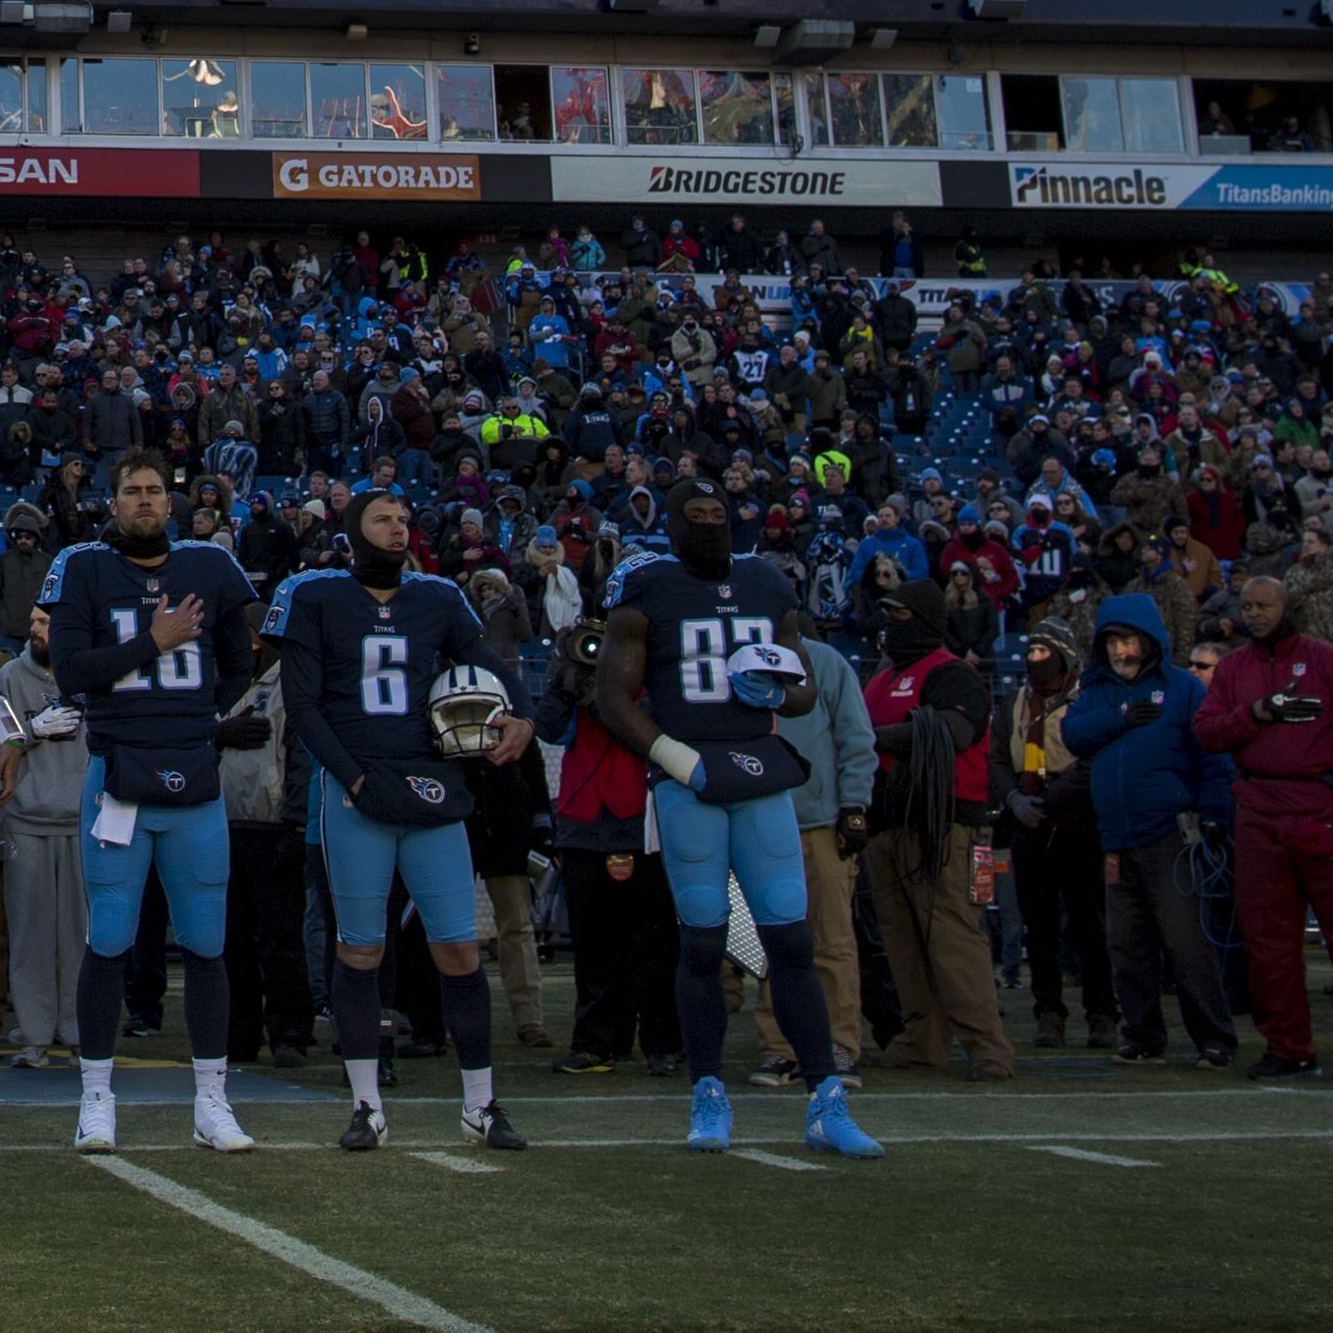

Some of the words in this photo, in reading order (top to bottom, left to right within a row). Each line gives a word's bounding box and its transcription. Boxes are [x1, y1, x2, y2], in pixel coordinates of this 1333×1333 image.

[279, 158, 310, 192] G
[318, 164, 474, 189] GATORADE
[648, 167, 845, 195] BRIDGESTONE
[1015, 166, 1166, 205] Pinnacle
[1216, 182, 1333, 208] TitansBankin
[743, 361, 763, 379] 27
[141, 597, 161, 605] TITAN
[715, 606, 739, 615] TITANS
[373, 625, 396, 634] TITANS
[360, 634, 410, 716] 6
